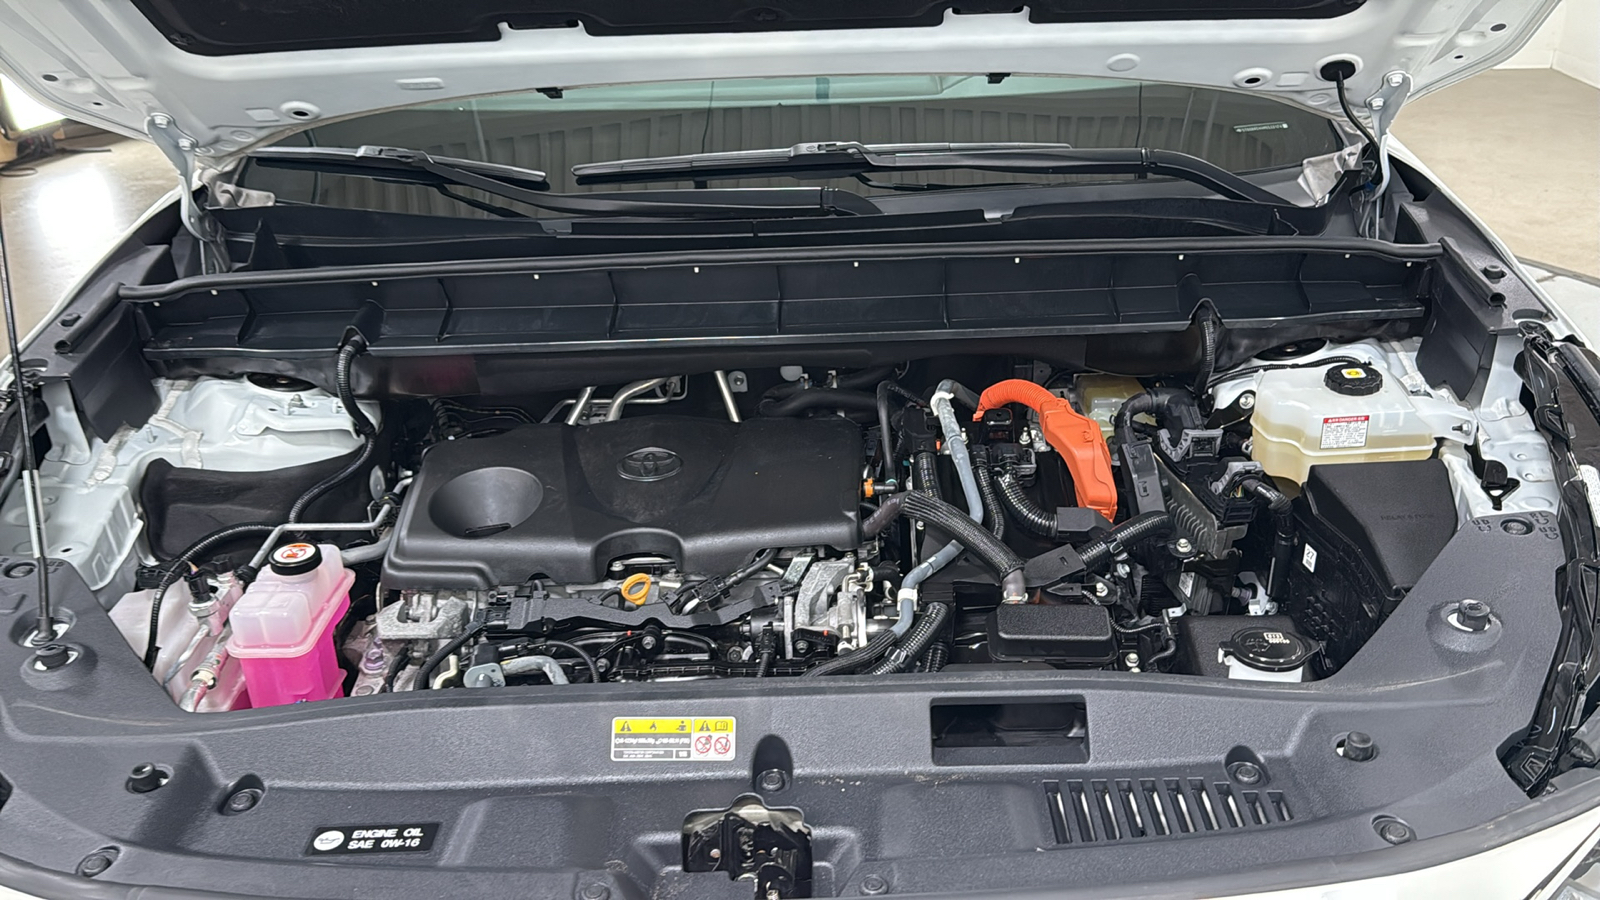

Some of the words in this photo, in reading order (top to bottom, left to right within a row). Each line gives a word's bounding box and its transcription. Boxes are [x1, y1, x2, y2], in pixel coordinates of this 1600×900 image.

[351, 828, 399, 839] ENGINE
[402, 827, 424, 837] OIL
[347, 839, 376, 850] SAE
[380, 838, 421, 848] 0W-16
